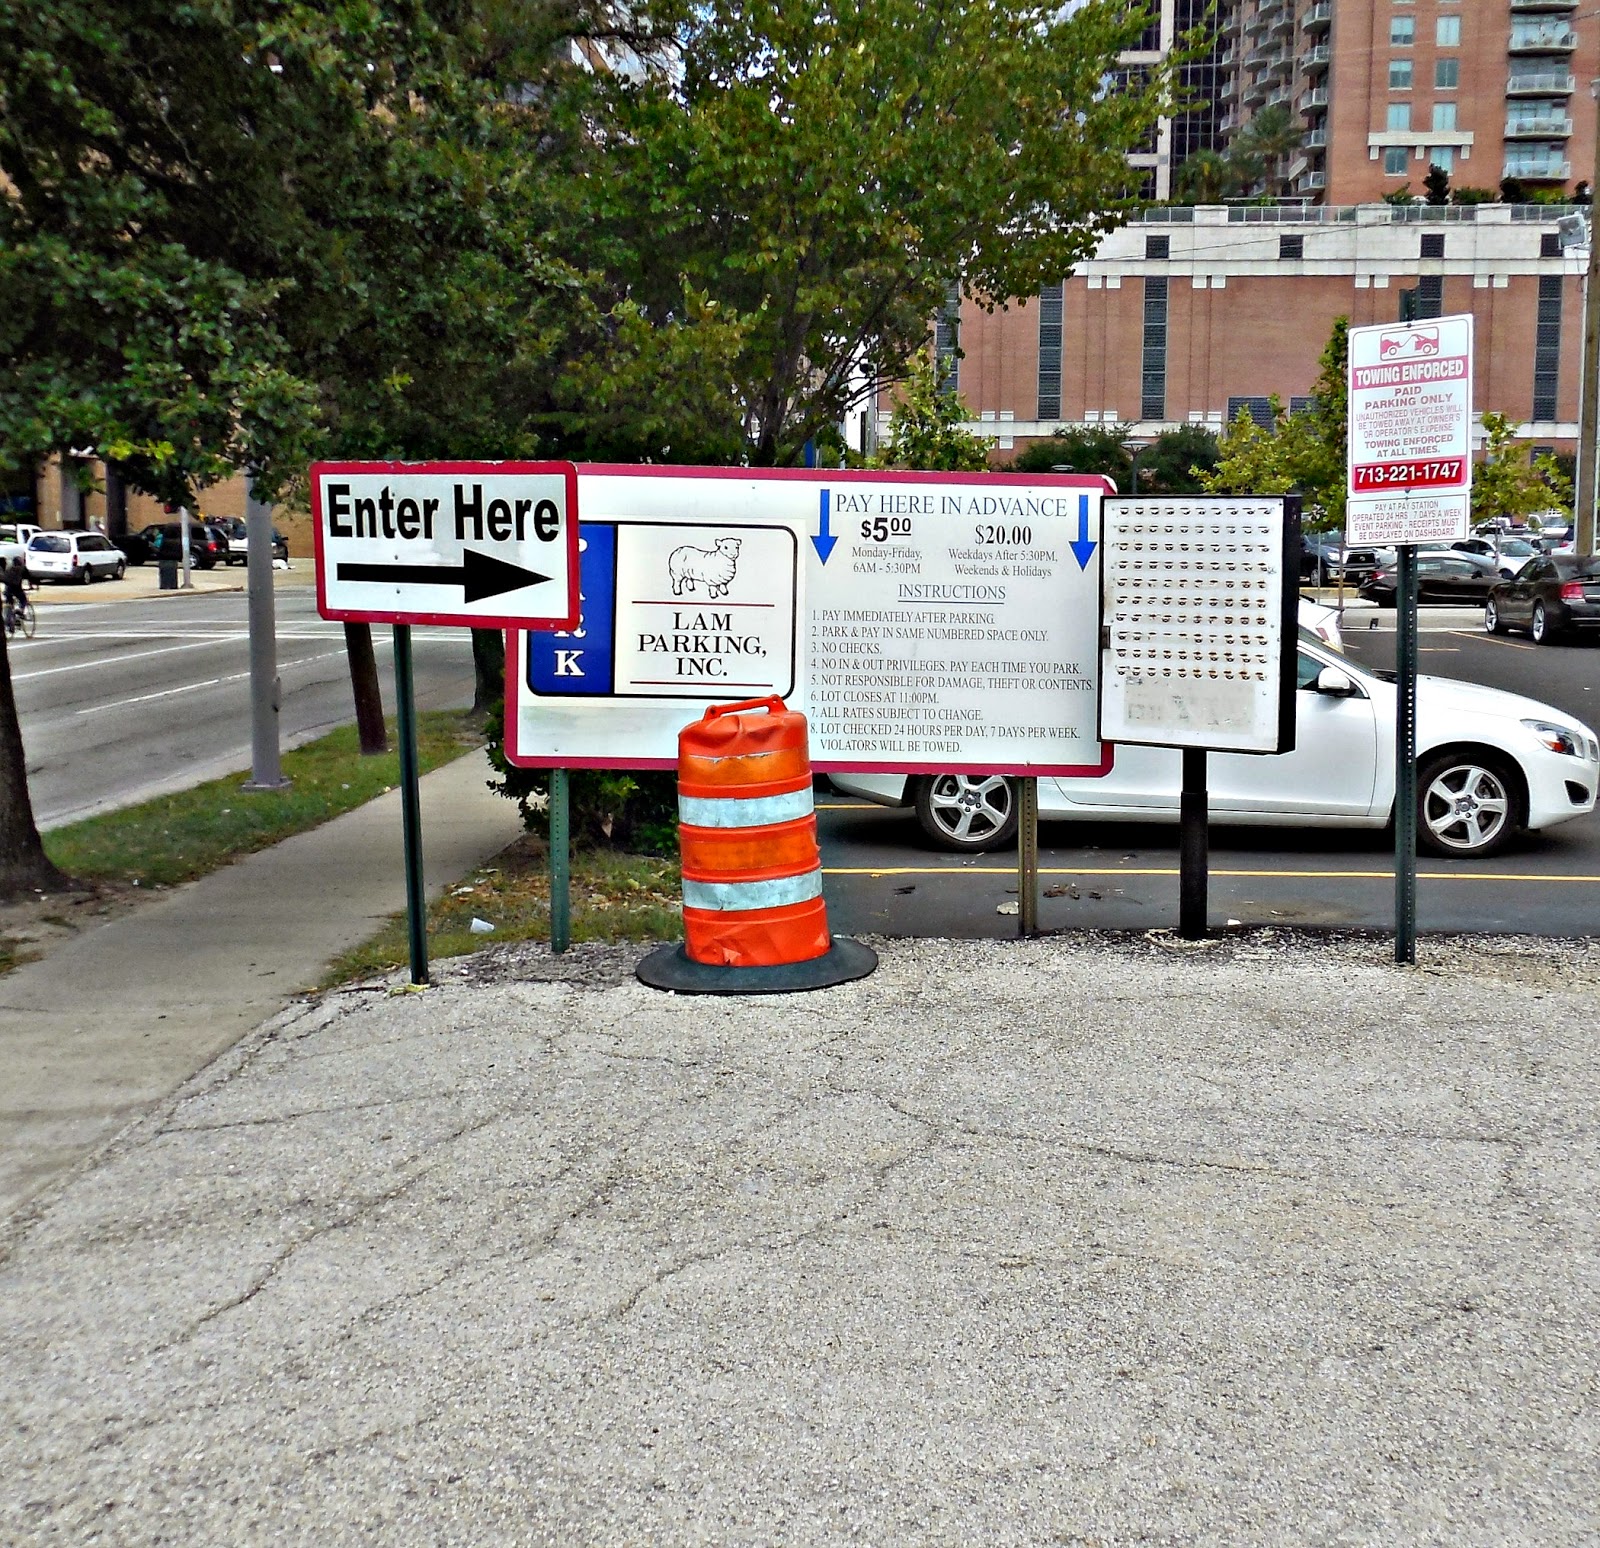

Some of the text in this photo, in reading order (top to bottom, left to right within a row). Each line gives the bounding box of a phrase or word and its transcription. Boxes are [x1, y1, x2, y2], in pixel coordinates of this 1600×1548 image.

[1356, 360, 1464, 386] TOWING ENFORCED
[1394, 386, 1422, 397] PAID
[1365, 393, 1453, 410] PARKING ONLY
[1356, 404, 1462, 421] UNAUTHORIZED VEHICLES WILL
[1358, 422, 1368, 430] BE
[1369, 420, 1393, 429] TOWED
[1395, 418, 1415, 427] AWAY
[1417, 416, 1426, 425] AT
[1363, 430, 1373, 439] OR
[1365, 434, 1453, 449] TOWING ENFORCED
[1377, 445, 1440, 458] AT ALL TIMES.
[1357, 462, 1460, 483] 713-221-1747
[327, 483, 560, 542] Enter Here
[835, 494, 1068, 517] PAY HERE IN ADVANCE
[1375, 500, 1439, 512] PAY AT PAY STATION
[1352, 513, 1384, 522] OPERATED
[1386, 512, 1394, 520] 24
[1419, 509, 1436, 518] DAYS
[1443, 508, 1462, 517] WEEK
[1354, 523, 1373, 531] EVENT
[1376, 521, 1403, 530] PARKING
[1408, 519, 1439, 529] RECEIPTS
[1441, 518, 1460, 527] MUST
[974, 524, 1032, 547] $20.00
[1358, 528, 1455, 540] BE DISPLAYED ON DASHBOARD
[948, 548, 993, 562] Weekdays
[995, 550, 1017, 561] After
[853, 562, 876, 573] 6AM
[885, 563, 921, 574] 5:30PM
[955, 564, 1052, 579] Weekends & Holidays
[898, 584, 1006, 600] INSTRUCTIONS
[673, 612, 733, 632] LAM
[822, 610, 841, 621] PAY
[843, 610, 914, 622] IMMEDIATELY
[914, 612, 947, 623] AFTER
[822, 626, 848, 637] PARK
[850, 626, 859, 638] &
[861, 627, 880, 638] PAY
[882, 627, 893, 638] IN
[896, 628, 924, 639] SAME
[927, 628, 985, 640] NUMBERED
[987, 629, 1017, 641] SPACE
[1020, 630, 1048, 641] ONLY.
[637, 633, 768, 658] PARKING,
[821, 642, 837, 653] NO
[839, 642, 882, 654] CHECKS.
[675, 657, 728, 677] INC.
[821, 658, 837, 669] NO
[839, 659, 850, 670] IN
[852, 659, 860, 670] &
[862, 659, 884, 670] OUT
[886, 660, 947, 672] PRIVILEGES.
[950, 661, 969, 672] PAY
[971, 661, 999, 673] EACH
[1001, 662, 1026, 673] TIME
[1029, 662, 1051, 674] YOU
[1053, 663, 1082, 674] PARK.
[821, 674, 842, 686] NOT
[845, 675, 913, 687] RESPONSIBLE
[915, 676, 935, 687] FOR
[988, 677, 1020, 689] THEFT
[1021, 678, 1036, 690] OR
[821, 691, 841, 702] LOT
[843, 691, 882, 702] CLOSES
[883, 692, 896, 703] AT
[820, 707, 840, 718] ALL
[843, 707, 874, 719] RATES
[876, 708, 920, 720] SUBJECT
[922, 709, 936, 720] TO
[938, 709, 983, 721] CHANGE.
[821, 723, 842, 734] LOT
[843, 723, 892, 735] CHECKED
[894, 724, 904, 735] 24
[907, 725, 942, 736] HOURS
[944, 725, 963, 737] PER
[991, 726, 996, 737] 7
[998, 726, 1025, 738] DAYS
[1027, 727, 1046, 738] PER
[1048, 727, 1081, 739] WEEK.
[820, 739, 962, 752] VIOLATORS WILL BE TOWED.
